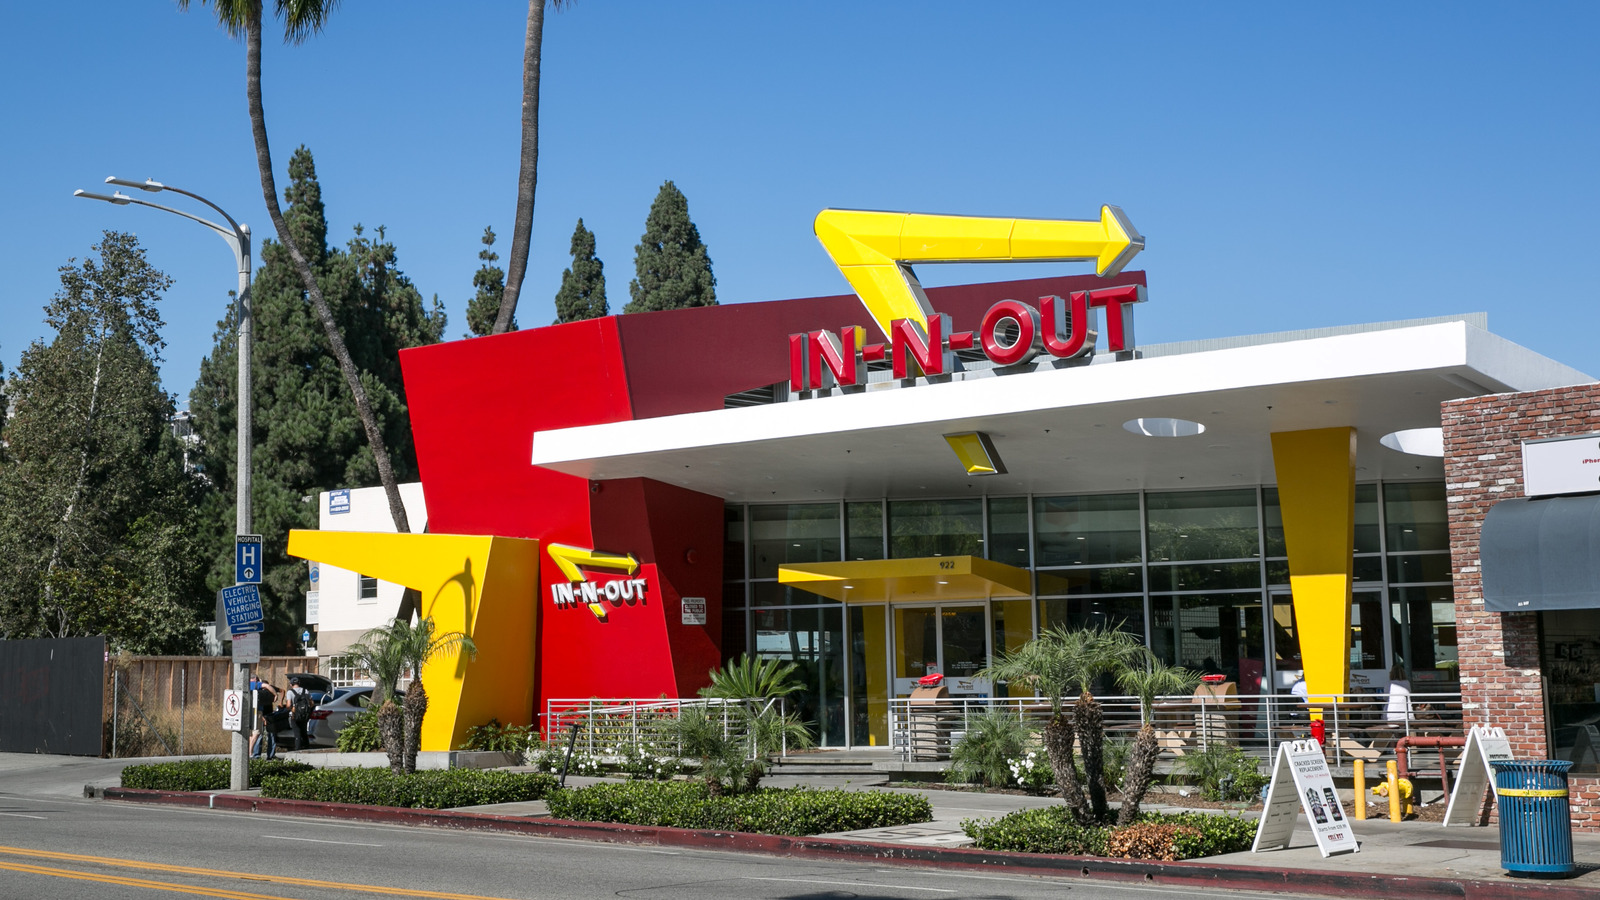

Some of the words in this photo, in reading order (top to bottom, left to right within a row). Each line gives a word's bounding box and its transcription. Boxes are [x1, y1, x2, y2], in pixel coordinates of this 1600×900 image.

[788, 284, 1147, 393] IN-N-OUT
[242, 546, 255, 565] H
[939, 561, 955, 569] 922
[224, 584, 256, 599] ELECTRIC
[551, 578, 647, 605] IN-N-OUT
[227, 593, 257, 606] VEHICLE
[226, 601, 261, 616] CHARGING
[231, 610, 259, 624] STATION
[1299, 765, 1324, 773] REPLACEMENT
